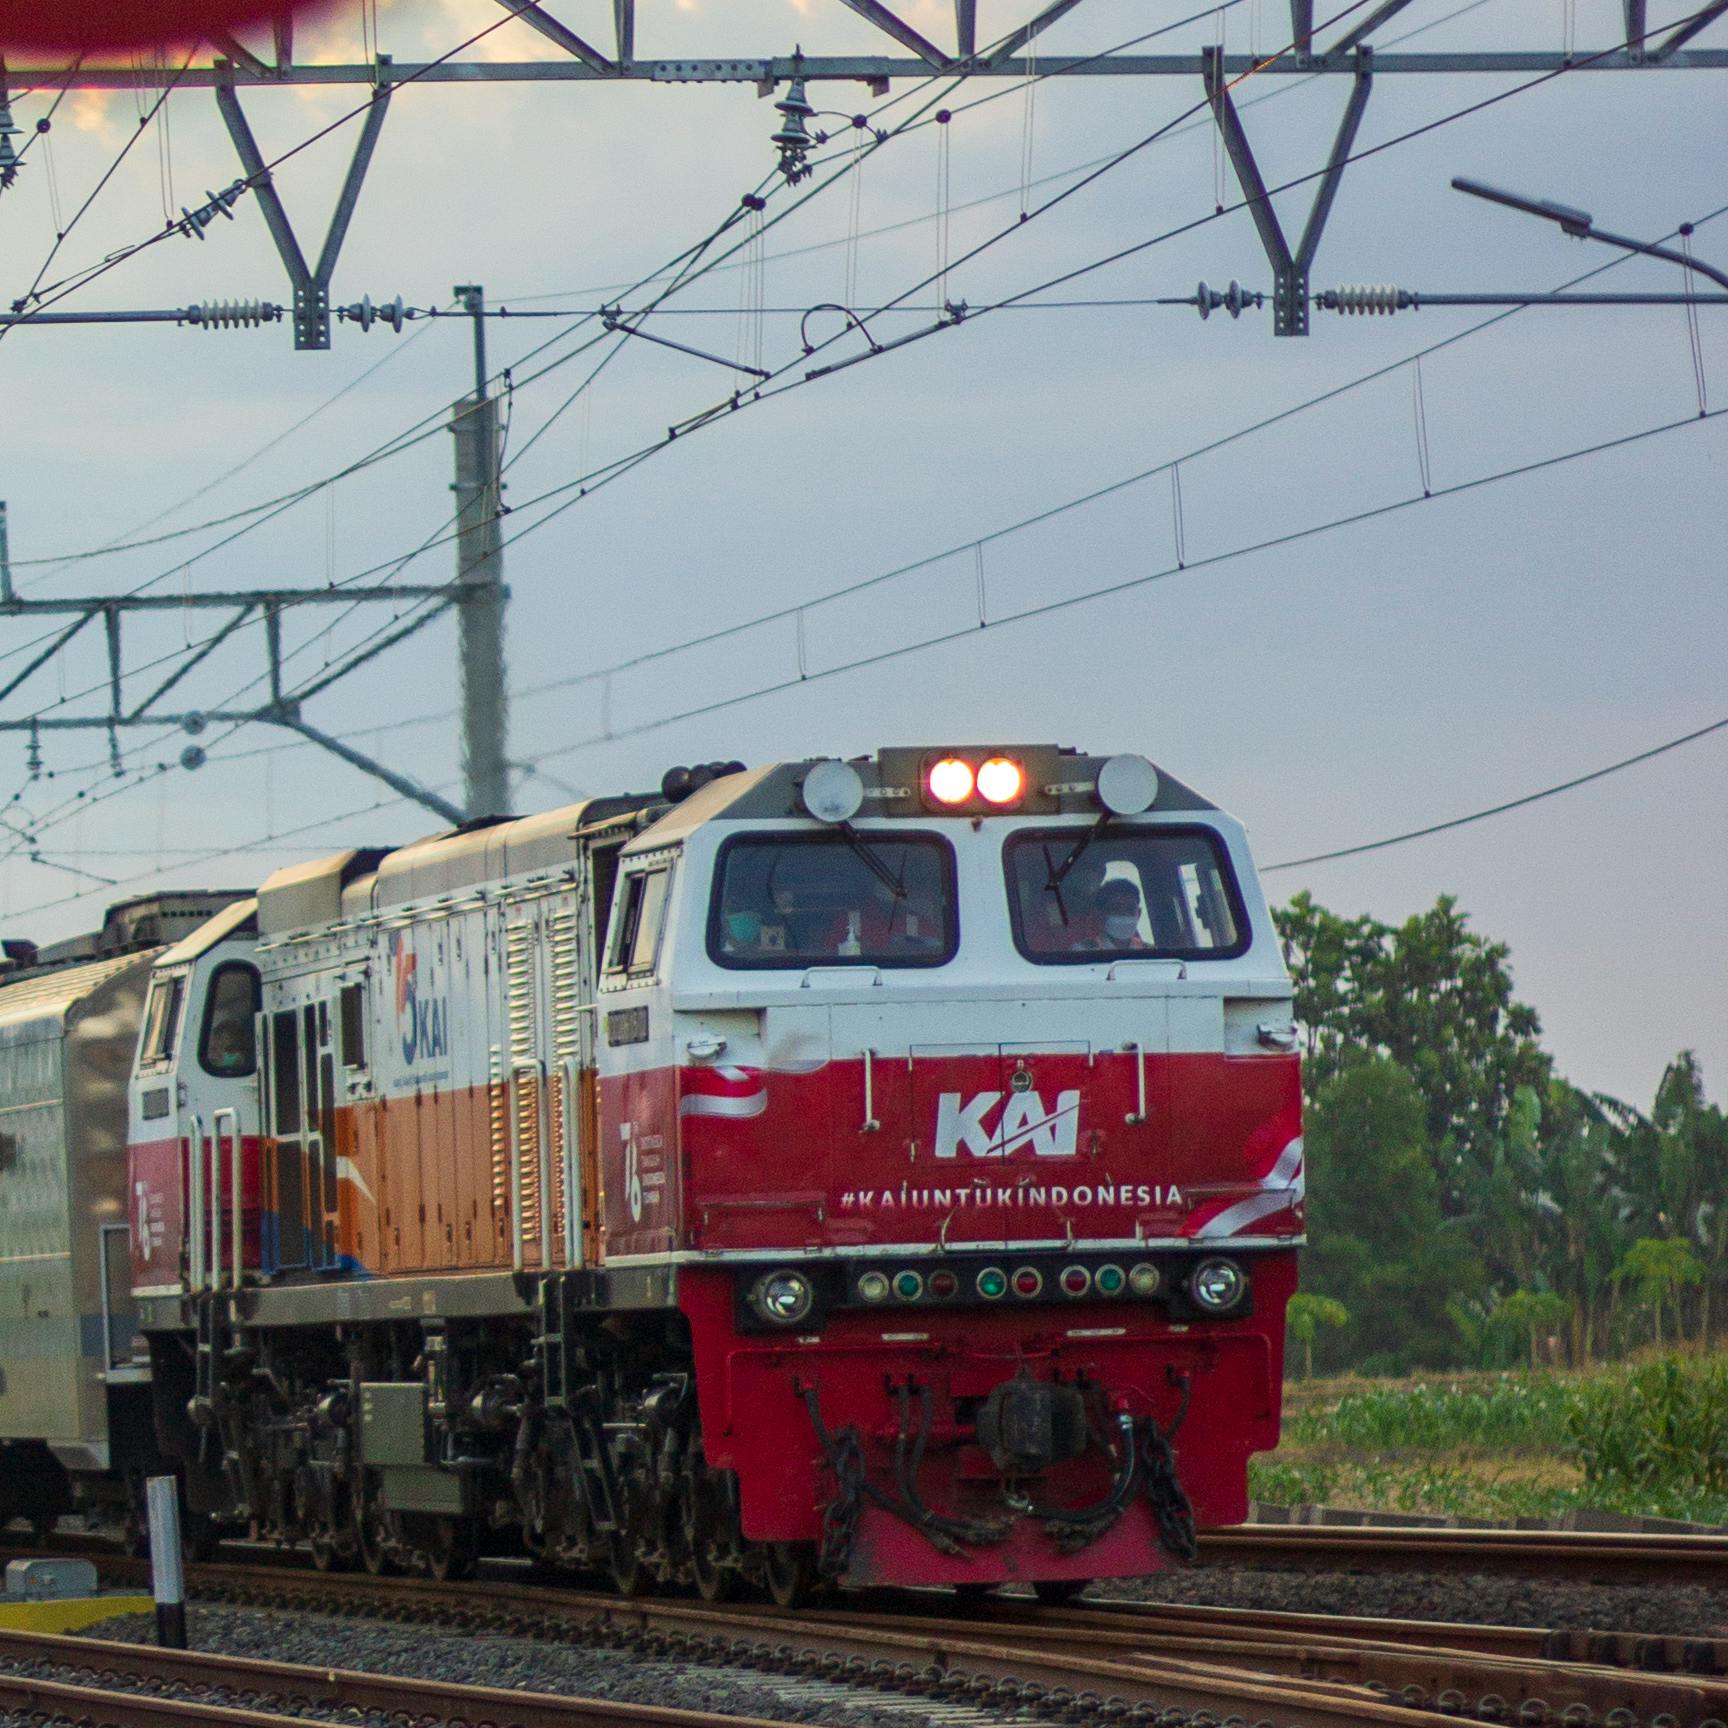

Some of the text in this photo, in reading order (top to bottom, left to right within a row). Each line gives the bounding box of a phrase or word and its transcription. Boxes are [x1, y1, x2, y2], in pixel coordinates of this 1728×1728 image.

[418, 996, 448, 1059] KAI
[935, 1090, 1081, 1158] KAI
[840, 1183, 1184, 1210] #KAIUNTUKINDONESIA
